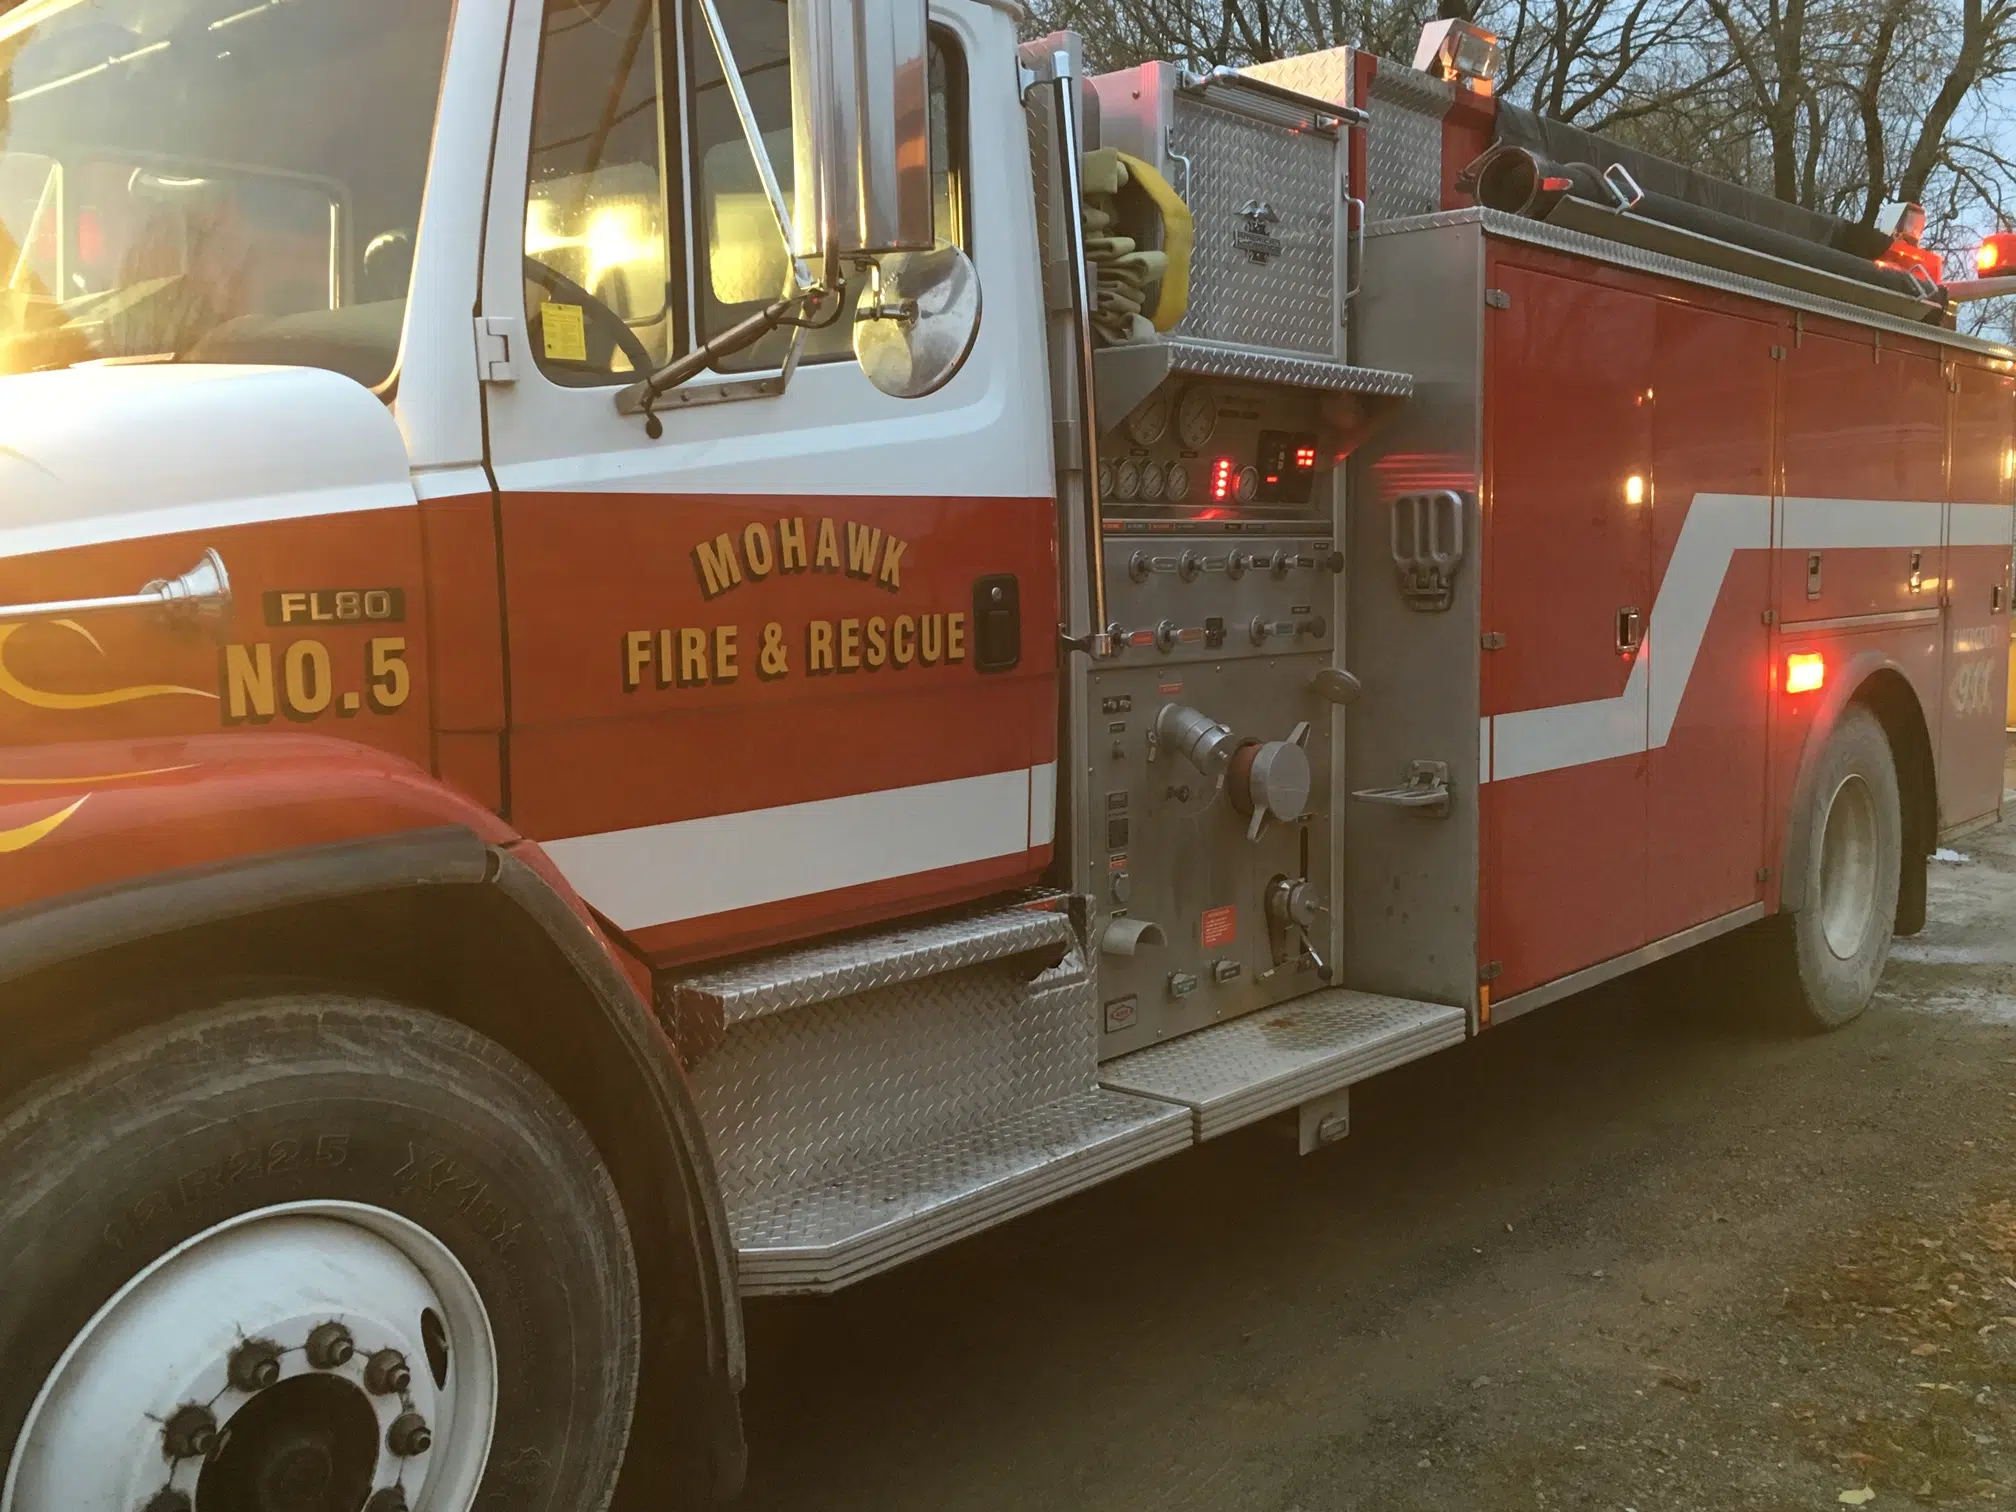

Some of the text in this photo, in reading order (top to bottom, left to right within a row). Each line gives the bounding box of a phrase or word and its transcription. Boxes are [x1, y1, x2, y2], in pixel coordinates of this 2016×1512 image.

[695, 517, 908, 597] MOHAWK
[280, 590, 392, 623] FL80
[626, 612, 966, 686] FIRE & RESCUE
